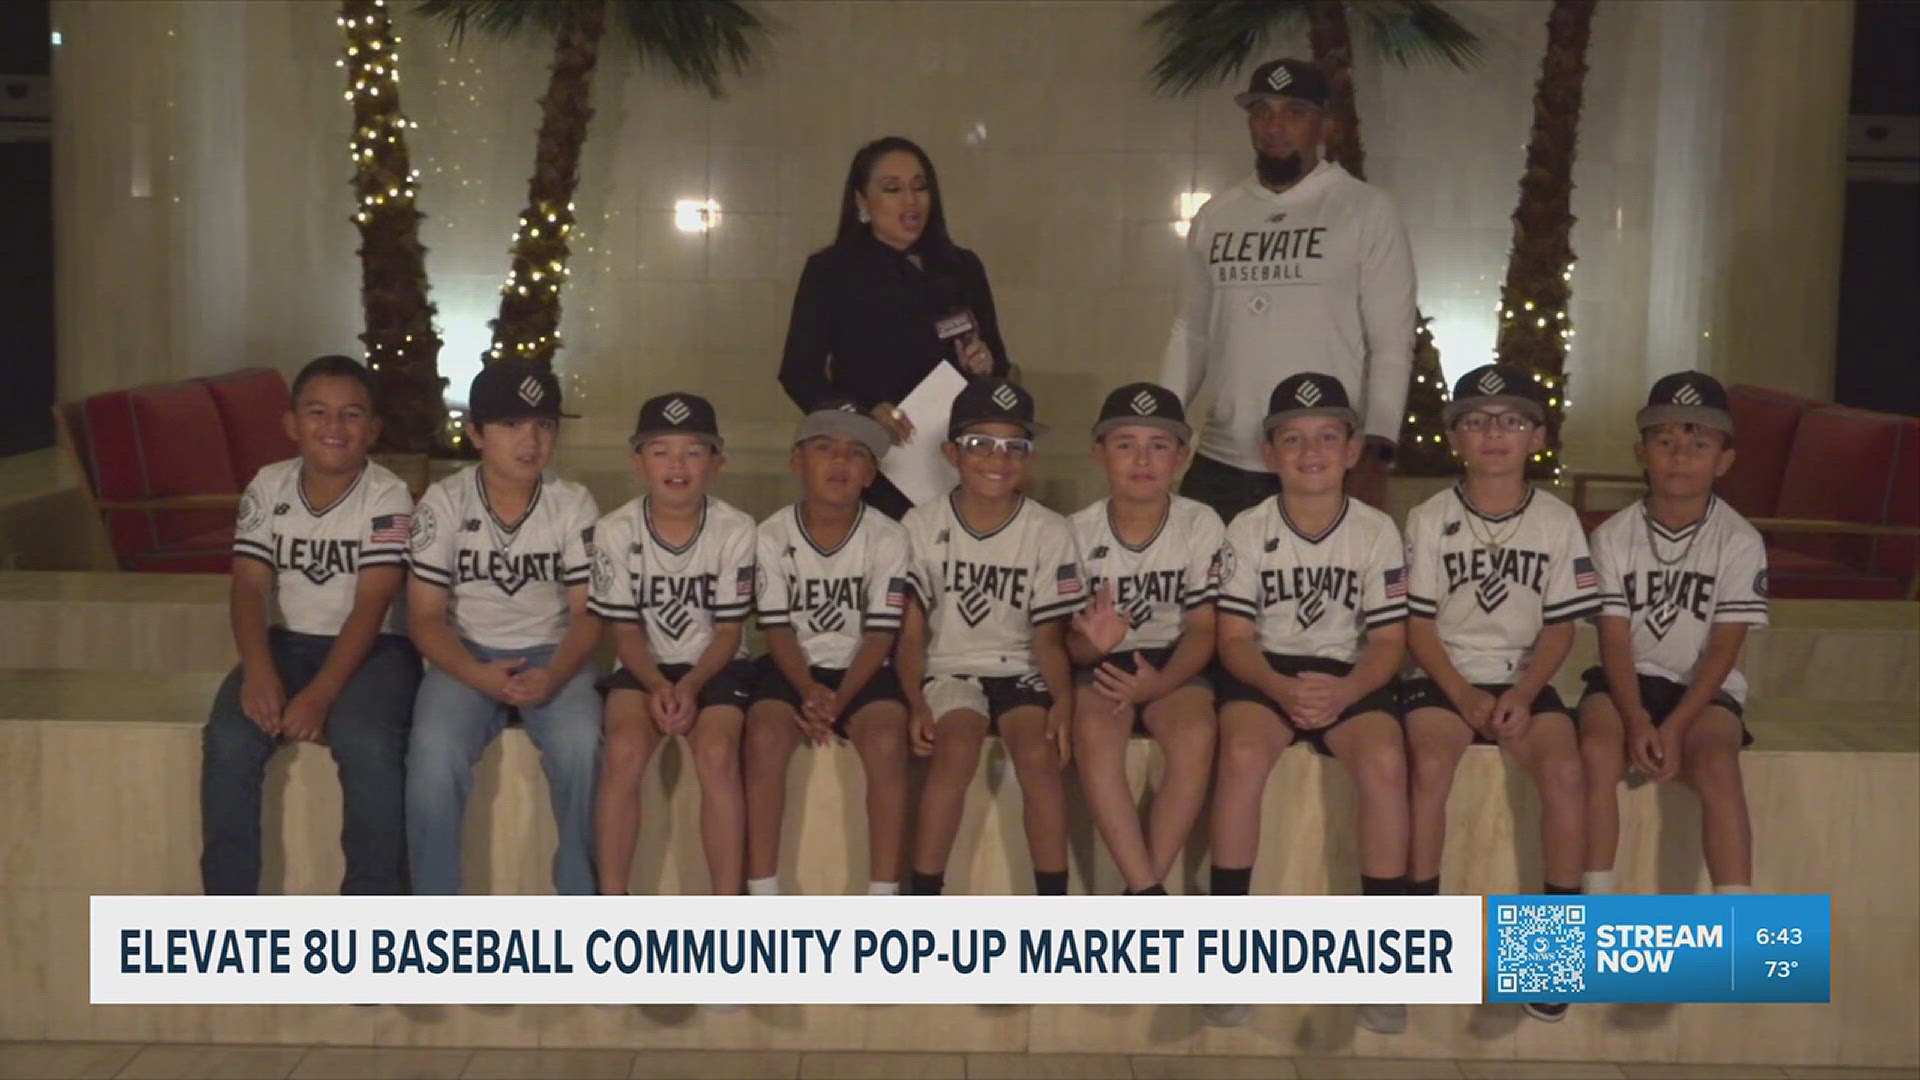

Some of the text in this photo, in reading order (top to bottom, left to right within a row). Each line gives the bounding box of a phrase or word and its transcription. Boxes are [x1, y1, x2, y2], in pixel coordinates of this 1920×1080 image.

[1209, 227, 1327, 264] ELEVATE
[1218, 263, 1303, 282] BASEBALL
[272, 533, 362, 573] LEVAT
[1443, 548, 1549, 594] ELEVATE
[942, 560, 1027, 609] LEVATE
[1261, 567, 1358, 609] ELEVATE
